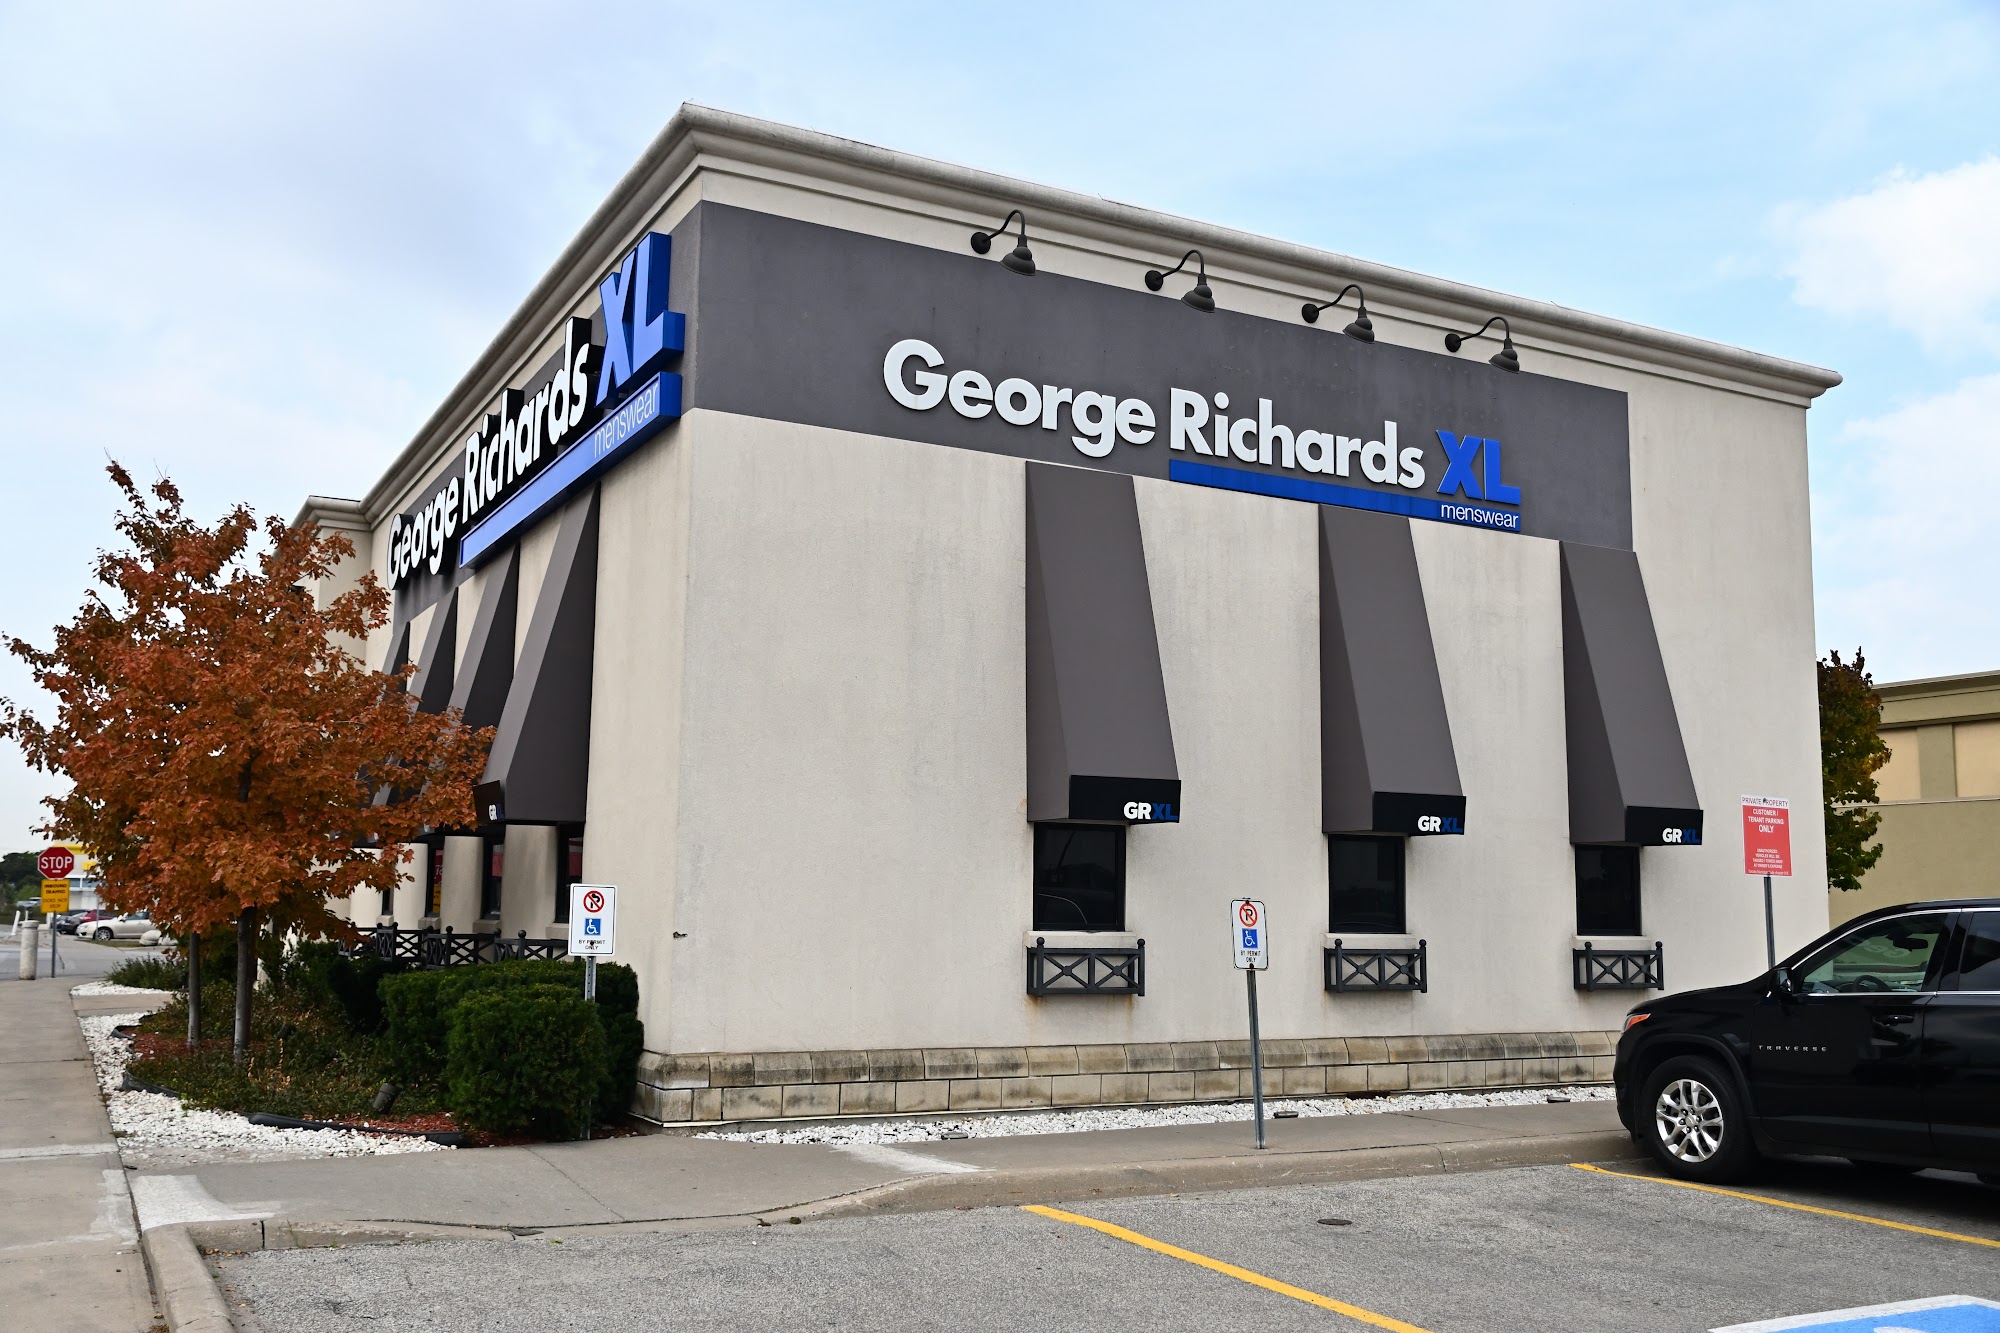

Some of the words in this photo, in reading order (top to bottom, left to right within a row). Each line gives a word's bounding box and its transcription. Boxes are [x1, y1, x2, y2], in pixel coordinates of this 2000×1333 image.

[387, 476, 459, 590] George
[462, 317, 590, 524] Richards
[595, 232, 682, 407] XL
[593, 379, 660, 459] menswear
[883, 338, 1156, 457] George
[1169, 387, 1425, 489] Richards
[1436, 430, 1520, 505] XL
[1440, 501, 1519, 529] menswear
[1123, 801, 1179, 821] GRXL
[1417, 815, 1464, 833] GRXL
[1758, 825, 1774, 833] ONLY
[1662, 827, 1702, 844] GRXL
[41, 856, 72, 869] STOP
[1758, 1044, 1827, 1052] TRAVERSE
